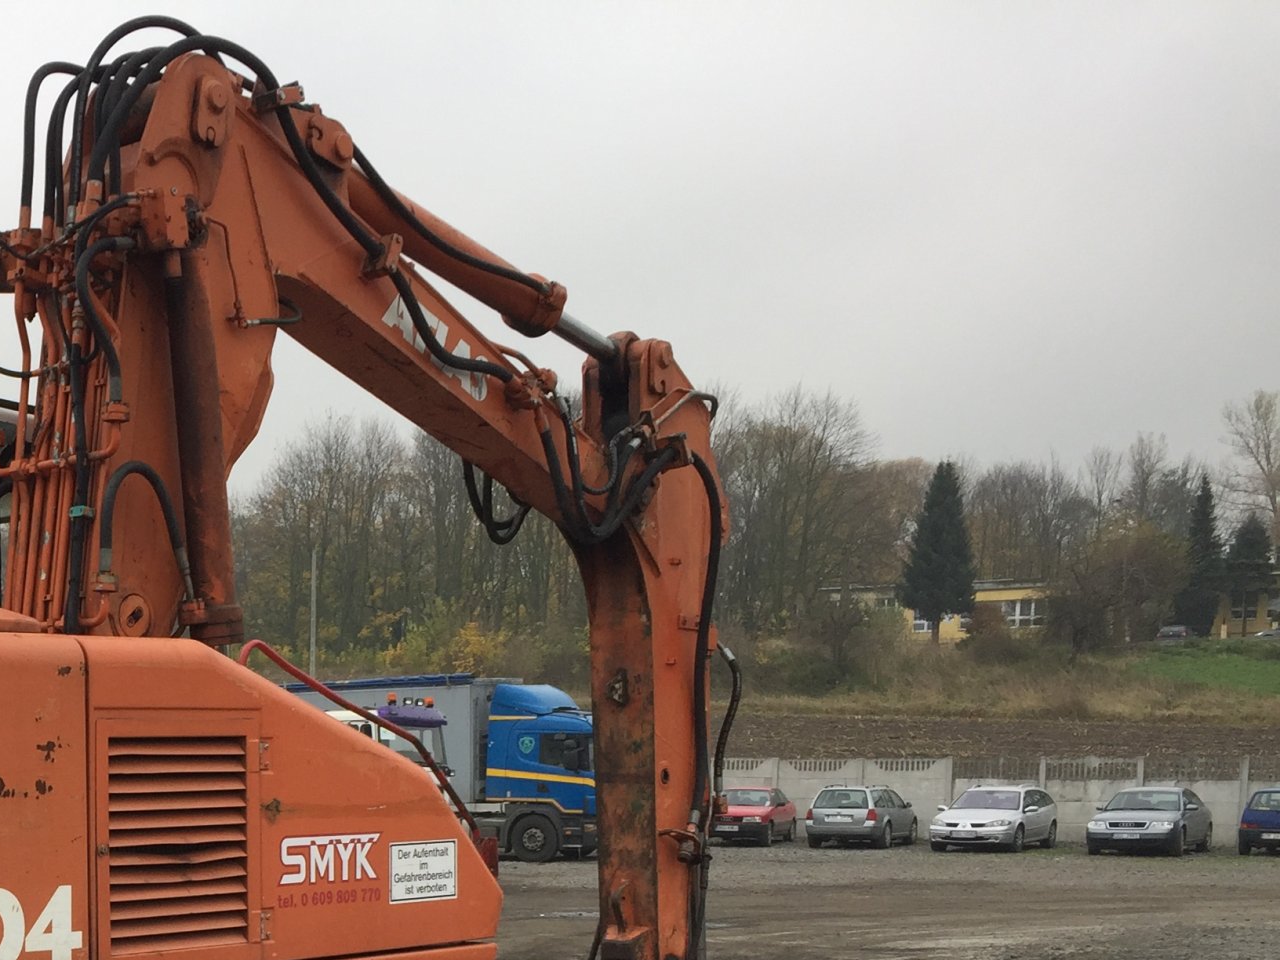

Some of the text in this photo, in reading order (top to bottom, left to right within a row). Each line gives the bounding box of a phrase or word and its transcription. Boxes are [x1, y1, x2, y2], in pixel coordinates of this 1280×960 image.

[278, 832, 383, 886] SMYK
[397, 847, 449, 860] Der Aufenthalt
[419, 861, 429, 870] im
[393, 869, 453, 884] Gefahrenbereich
[404, 883, 447, 895] ist verboten
[277, 893, 297, 908] tel.
[301, 893, 309, 906] 0
[312, 890, 333, 905] 609
[361, 887, 381, 902] 770
